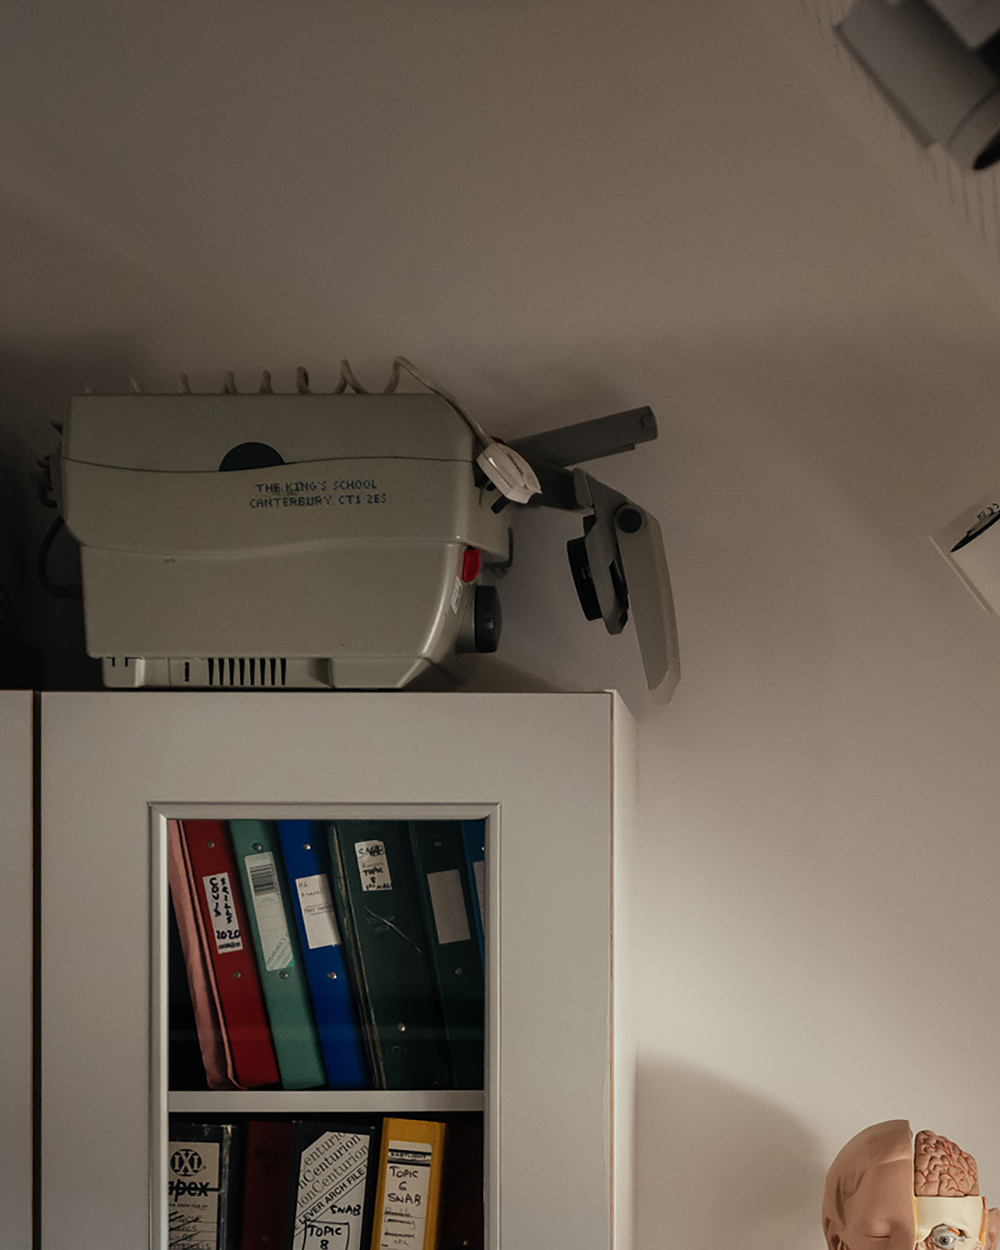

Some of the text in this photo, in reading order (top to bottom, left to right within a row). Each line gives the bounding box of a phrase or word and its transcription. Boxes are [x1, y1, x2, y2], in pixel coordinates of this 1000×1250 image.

[255, 480, 377, 493] THE KING'S SCHOOL
[250, 493, 387, 508] CANTERBURY CT1 2ES
[216, 930, 241, 940] 2020
[389, 1166, 418, 1178] TOPIC
[298, 1168, 366, 1225] LEVER ARCH FILE
[331, 1204, 361, 1216] SNAB
[307, 1224, 342, 1237] TOPIC
[320, 1239, 329, 1250] 8
